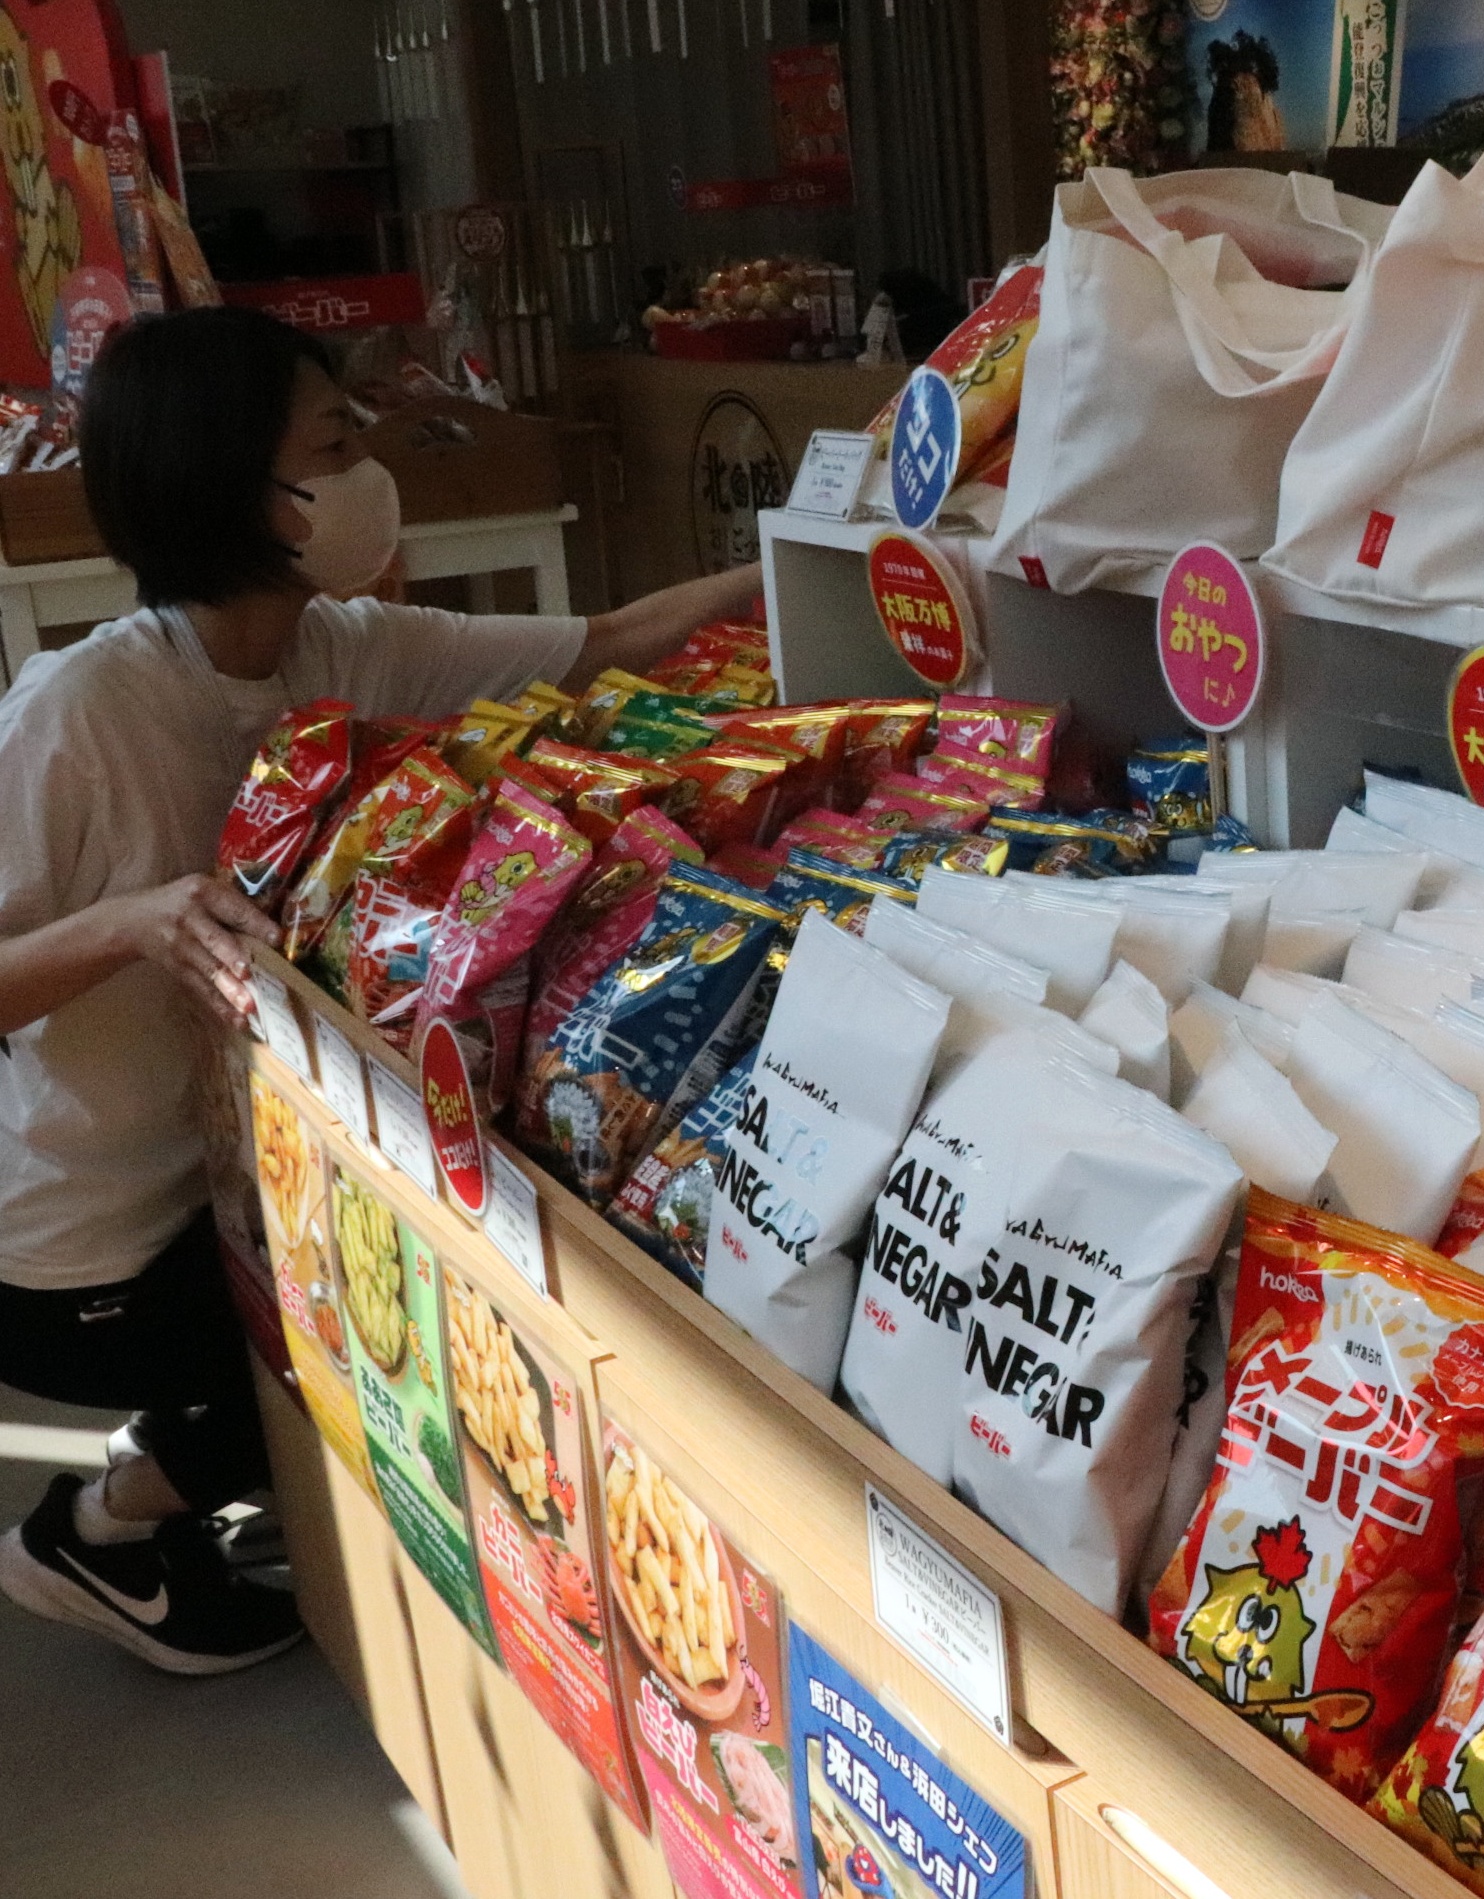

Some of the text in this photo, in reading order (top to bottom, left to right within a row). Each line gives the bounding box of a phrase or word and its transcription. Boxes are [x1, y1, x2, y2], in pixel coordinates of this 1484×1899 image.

[881, 593, 951, 632] 大阪万博
[1183, 570, 1227, 607] 今日の
[1169, 604, 1248, 674] おやつ
[883, 1157, 967, 1247] ALT&
[1258, 1265, 1320, 1304] hokka
[1235, 1339, 1440, 1470] メープル
[1450, 1374, 1480, 1394] 使用
[899, 1533, 983, 1621] WAGYUMAFIA
[922, 1607, 950, 1645] ¥300
[634, 1699, 721, 1815] ビーバー
[808, 1677, 999, 1876] 堀江貴文さん&浜田シェフ
